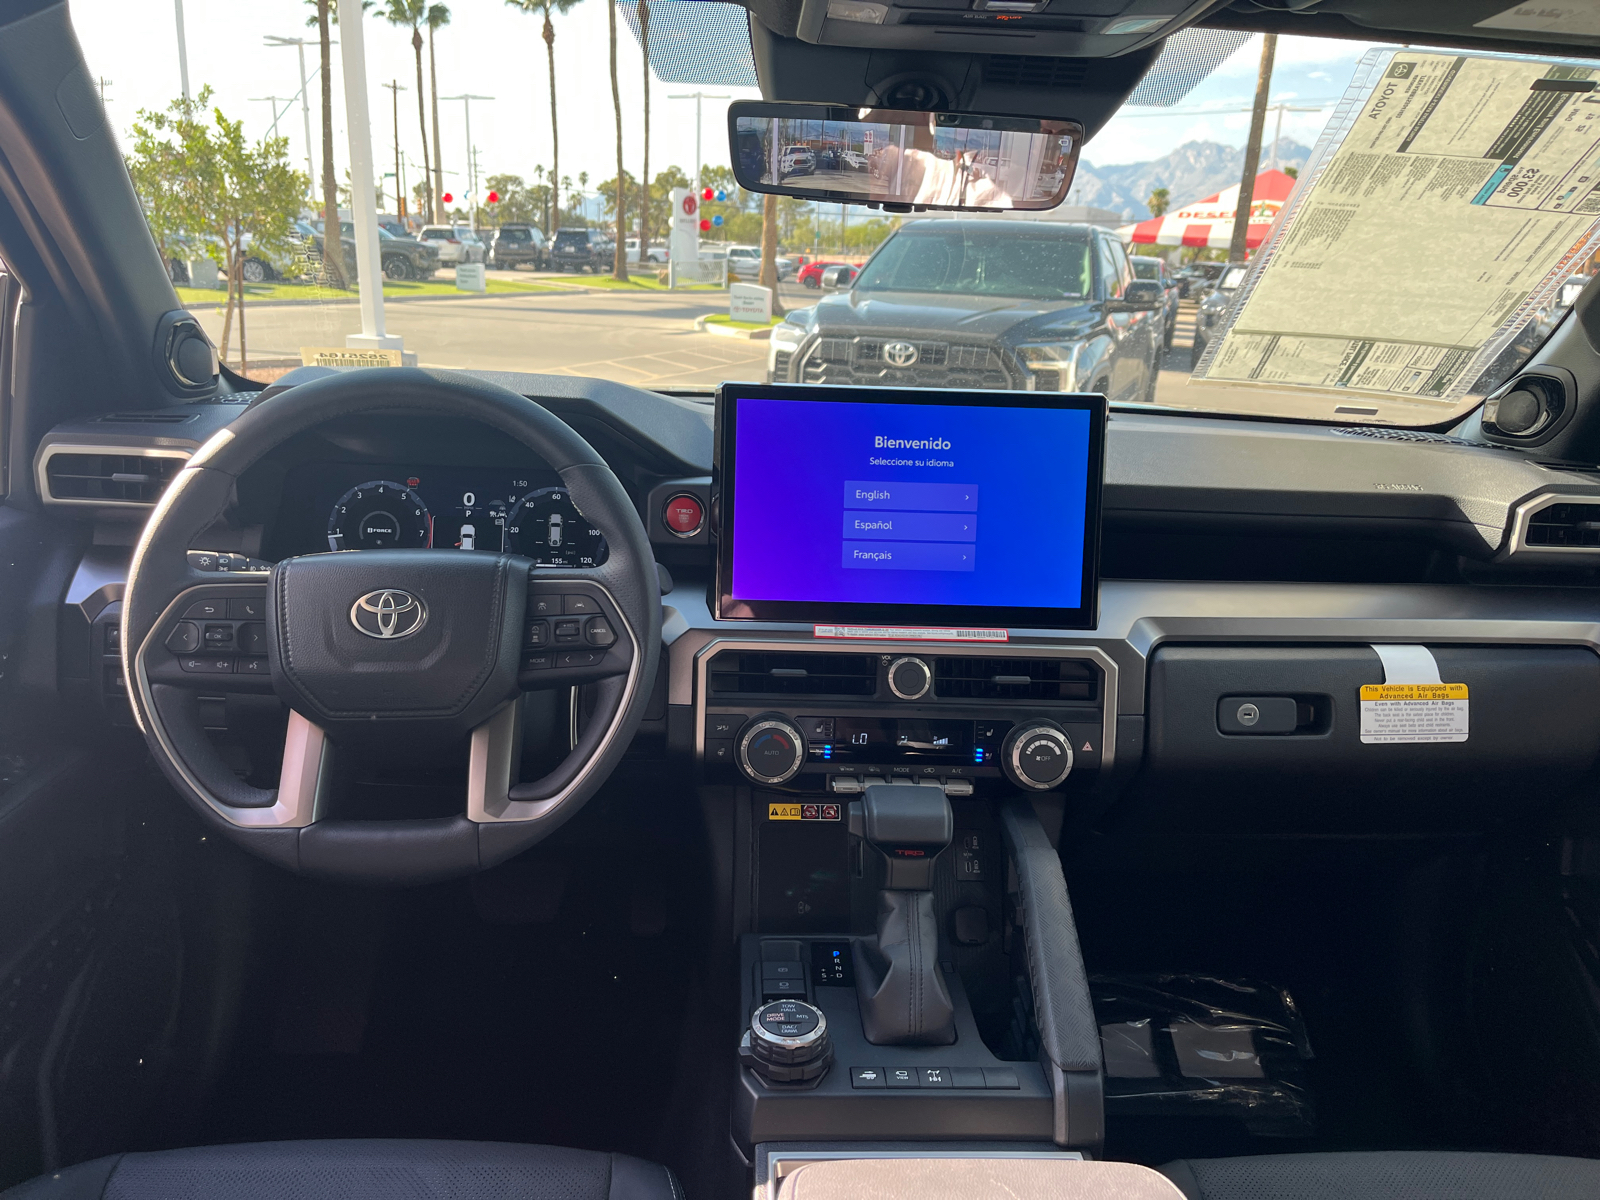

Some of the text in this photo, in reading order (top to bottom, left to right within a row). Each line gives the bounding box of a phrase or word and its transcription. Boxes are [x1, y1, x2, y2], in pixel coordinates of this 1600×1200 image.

[875, 436, 951, 450] Bienvenido
[870, 457, 913, 466] Seleccione
[926, 458, 954, 467] idioma
[463, 492, 475, 506] 0
[855, 489, 890, 501] English
[854, 520, 893, 531] Español
[853, 550, 892, 561] Français
[852, 733, 868, 745] LO
